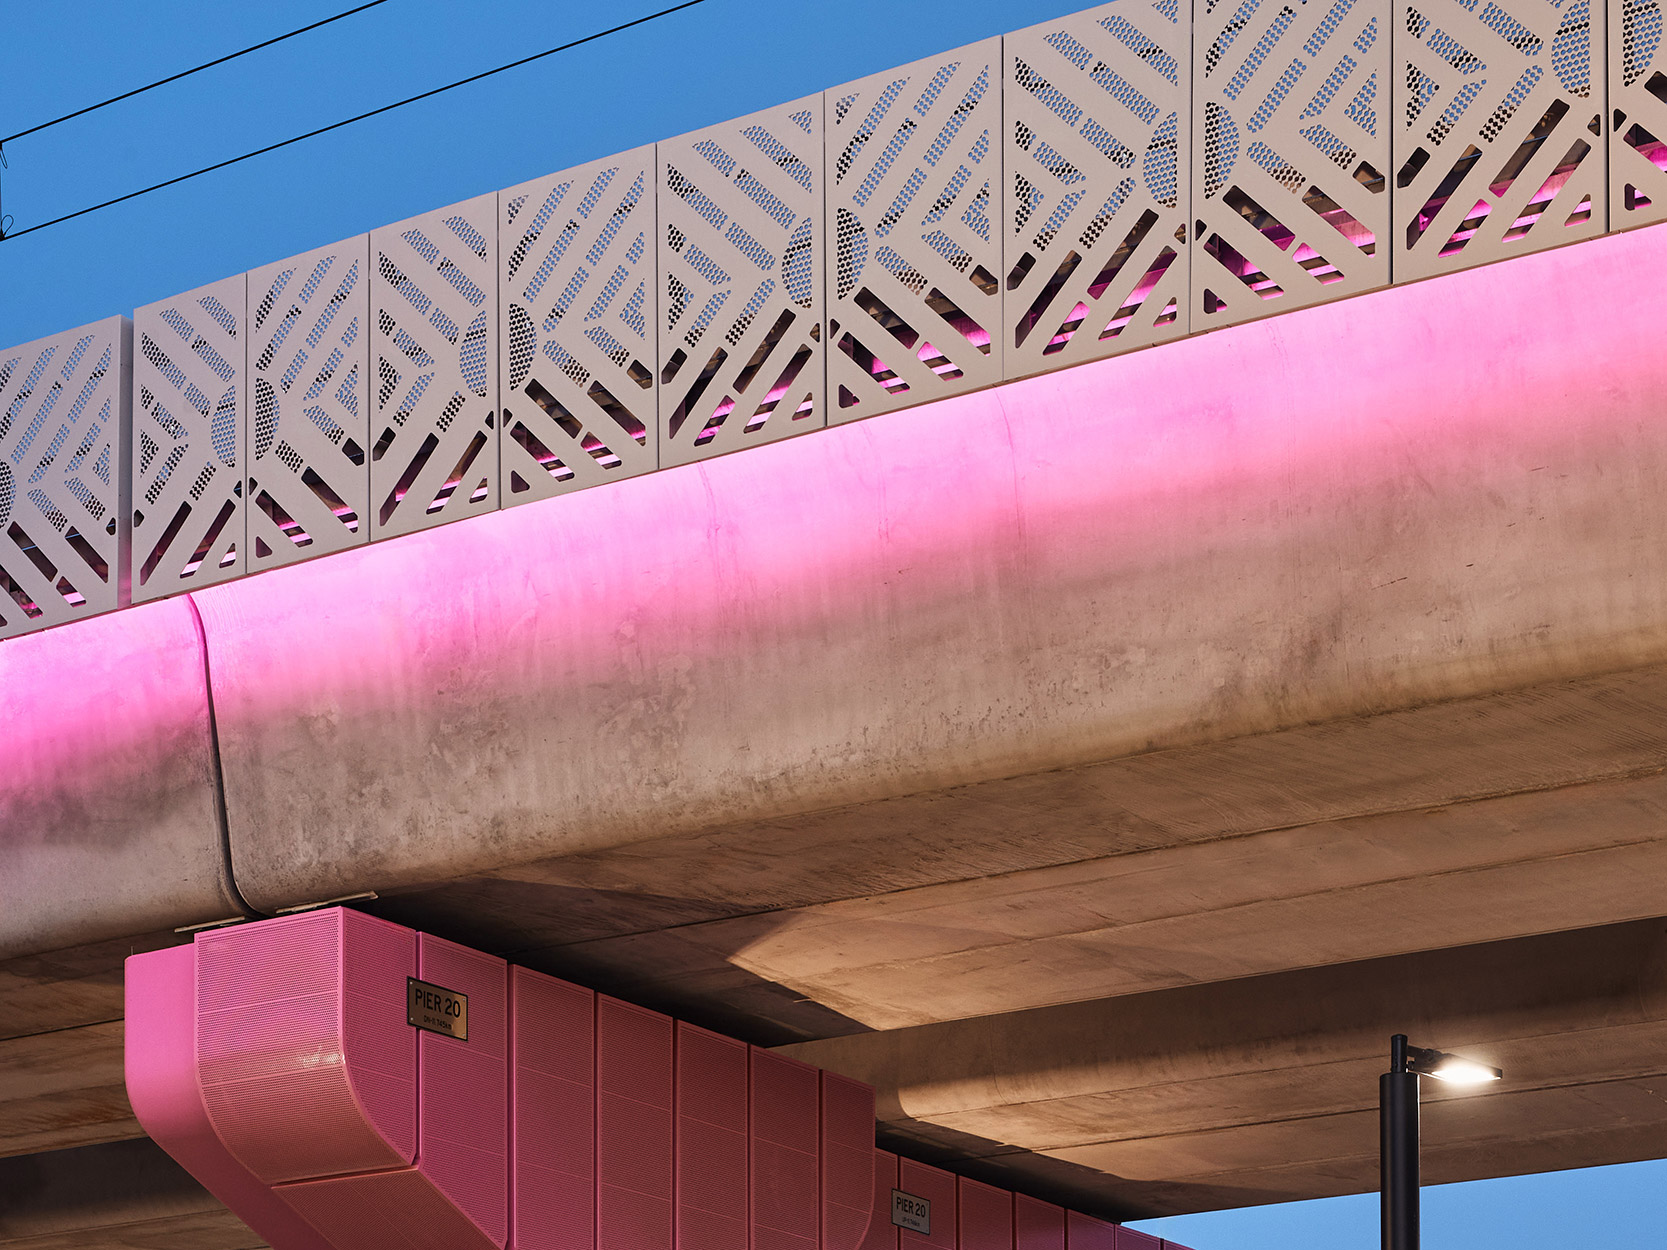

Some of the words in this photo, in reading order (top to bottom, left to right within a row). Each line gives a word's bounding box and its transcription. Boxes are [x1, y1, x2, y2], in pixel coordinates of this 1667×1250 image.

[415, 988, 441, 1013] PIER
[445, 998, 461, 1018] 20
[896, 1196, 914, 1215] PIER
[915, 1203, 926, 1218] 20
